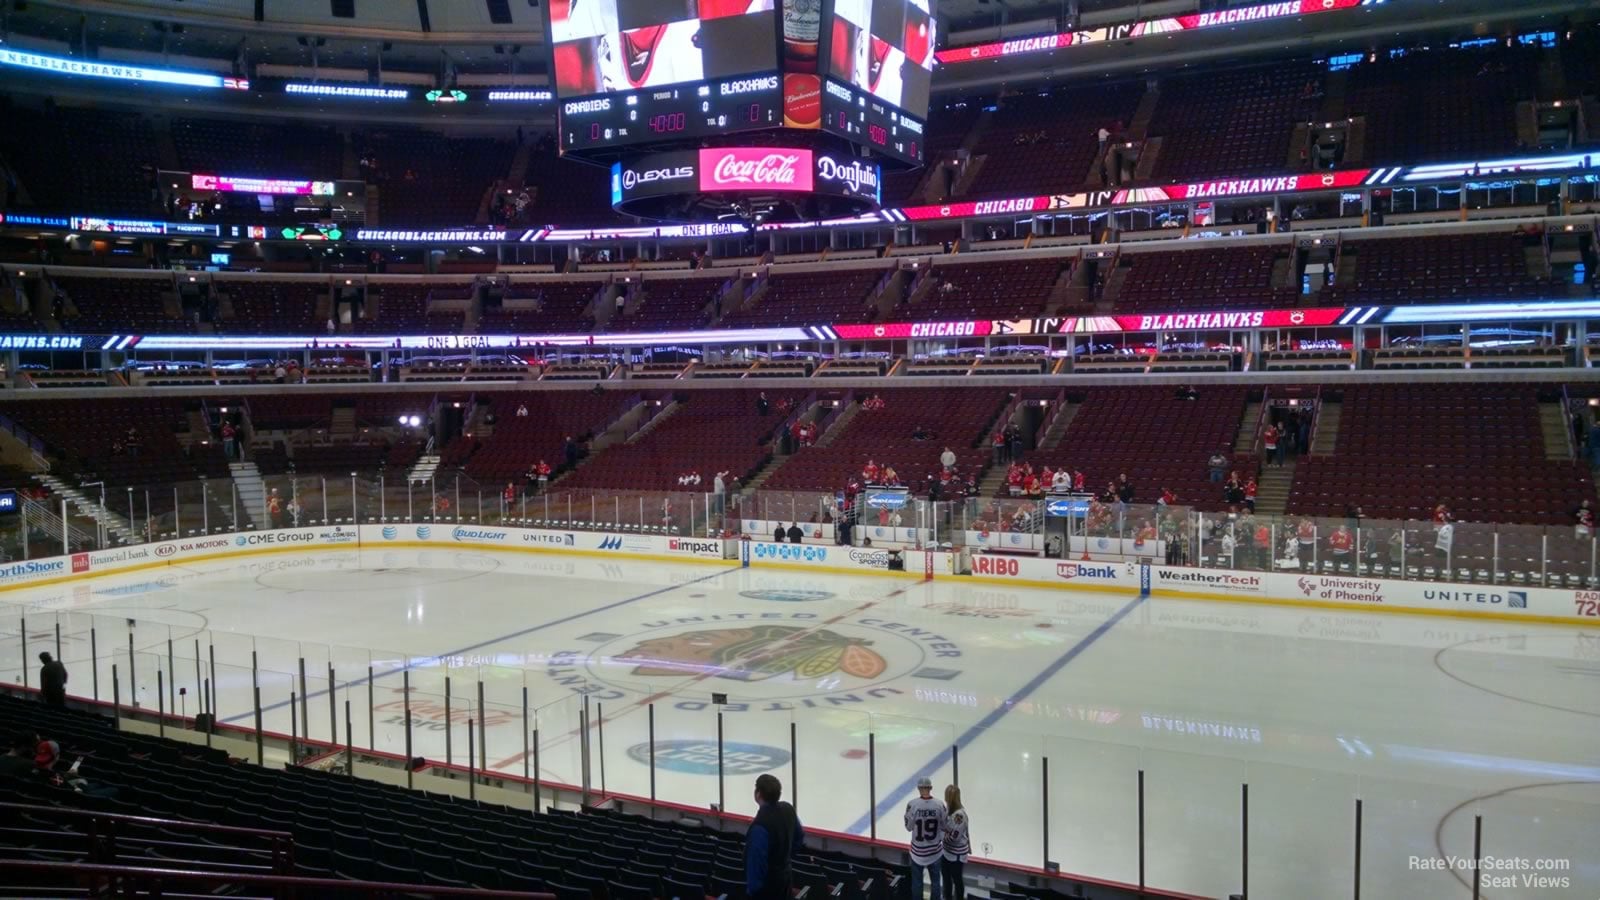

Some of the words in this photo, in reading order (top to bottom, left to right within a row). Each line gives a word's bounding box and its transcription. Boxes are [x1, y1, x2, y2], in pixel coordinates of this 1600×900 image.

[1002, 33, 1059, 55] CHICAGO
[1197, 1, 1301, 27] BLACKHAWKS
[285, 83, 408, 99] CHICAGOBLACKHAWKS.COM
[720, 76, 778, 96] BLACKHAWKS
[565, 98, 611, 115] CANADIENS
[649, 113, 685, 133] 40:00
[636, 166, 694, 183] LEXUS
[714, 153, 799, 185] Coca-Cola
[974, 196, 1034, 215] CHICAGO
[1185, 176, 1299, 198] BLACKHAWKS
[6, 215, 41, 224] HARRIS
[44, 217, 68, 226] CLUB
[357, 229, 506, 241] CHICAGOBLACKHAWKS.COM
[682, 225, 703, 236] ONE
[711, 223, 733, 235] GOAL
[910, 321, 975, 337] CHICAGO
[1139, 312, 1264, 330] BLACKHAWKS
[0, 336, 83, 349] AWKS.COM
[427, 336, 449, 348] ONE
[462, 336, 491, 348] GOAL
[248, 532, 275, 545] CME
[277, 530, 314, 545] Group
[456, 529, 477, 539] BUD
[478, 531, 508, 541] LIGHT
[523, 533, 562, 543] UNITED
[157, 545, 175, 556] KIA
[180, 542, 194, 551] KIA
[195, 539, 229, 550] MOTORS
[678, 538, 719, 554] impact
[90, 551, 126, 566] financial
[128, 548, 150, 560] bank
[1158, 570, 1260, 585] WeatherTech
[1320, 578, 1381, 592] University
[1320, 589, 1334, 599] of
[1335, 590, 1384, 602] Phoenix
[1424, 590, 1503, 604] UNITED
[641, 612, 818, 628] UNITED
[858, 618, 963, 660] CENTER
[546, 650, 625, 701] CENTER
[674, 687, 904, 712] UNITED
[914, 818, 939, 842] 19
